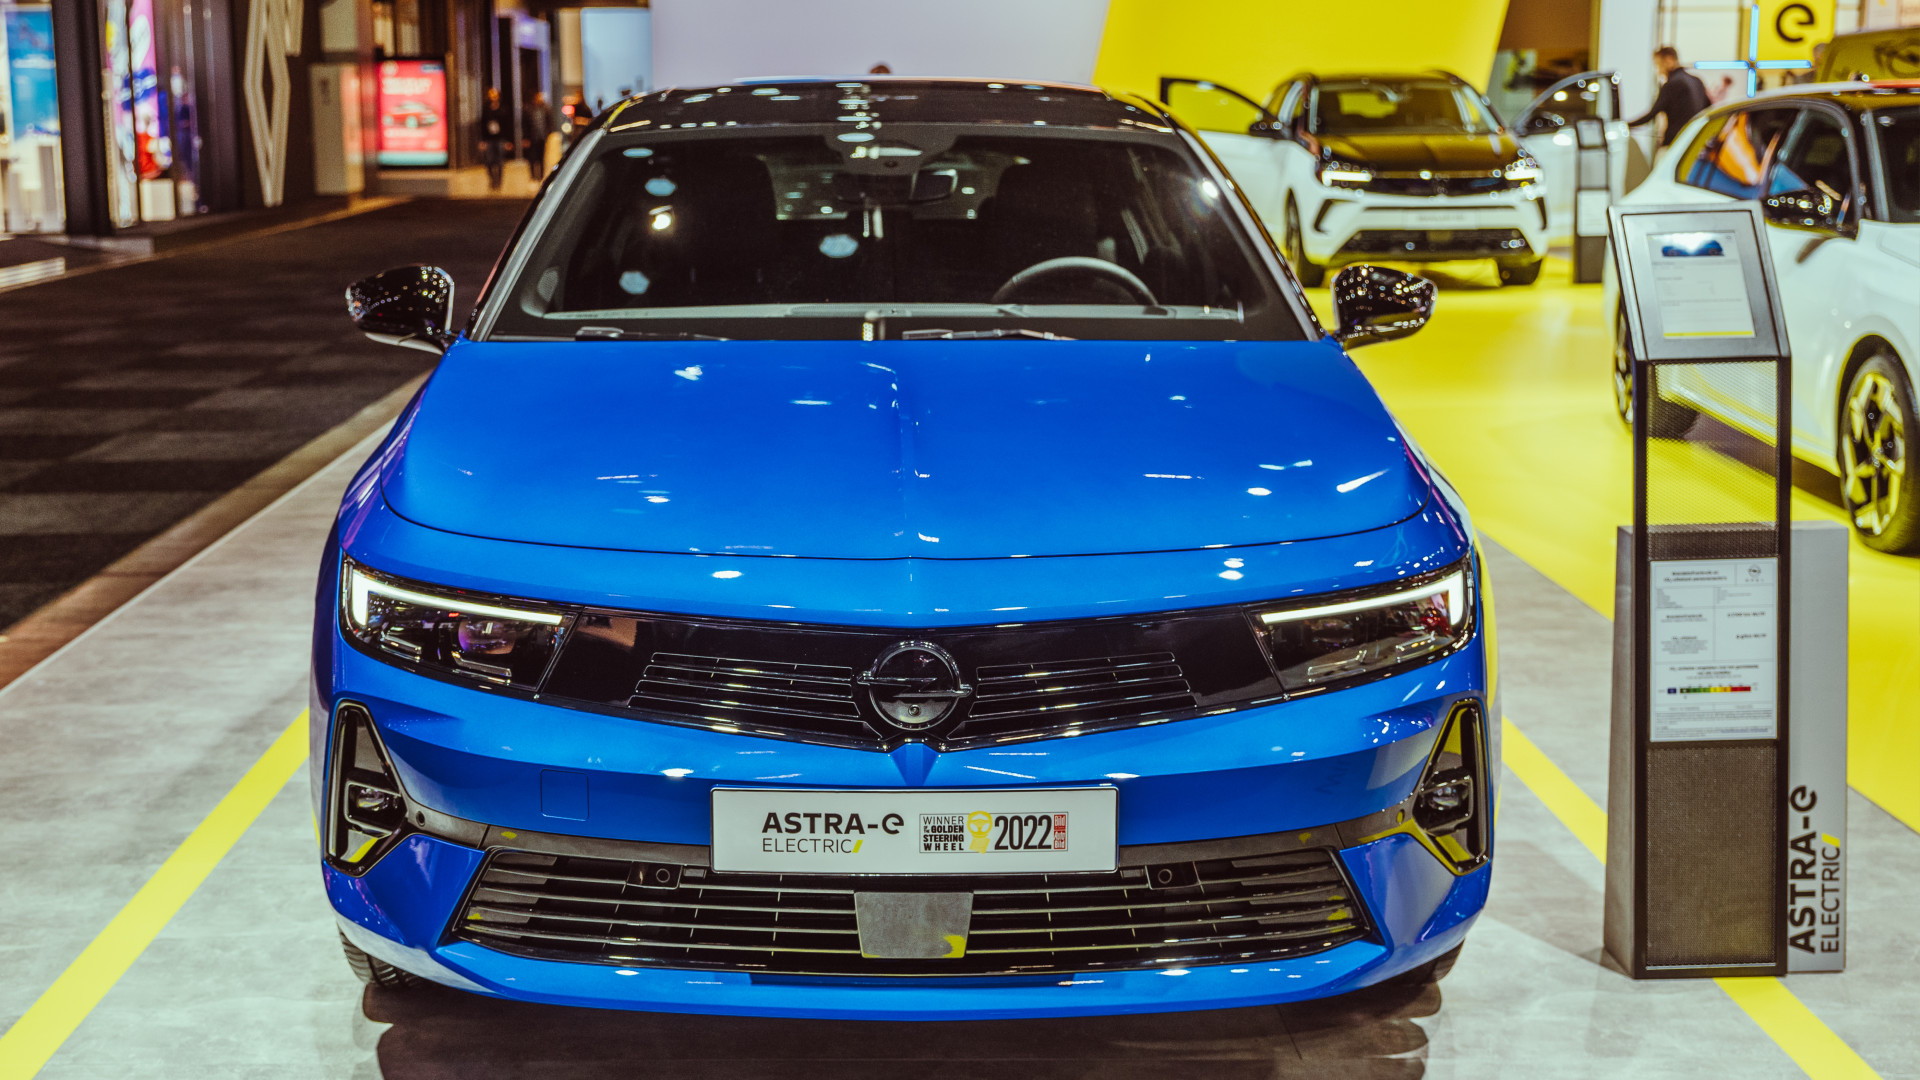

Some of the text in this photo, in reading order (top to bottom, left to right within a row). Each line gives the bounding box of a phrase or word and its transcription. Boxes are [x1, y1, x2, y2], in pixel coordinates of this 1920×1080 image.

[1776, 4, 1814, 43] e
[762, 812, 905, 835] ASTRA-e
[923, 816, 965, 825] WINNER
[931, 825, 965, 833] GOLDEN
[923, 834, 965, 843] STEERING
[994, 815, 1052, 850] 2022
[762, 838, 853, 853] ELECTRIC
[923, 843, 965, 851] WHEEL
[1788, 784, 1817, 954] ASTRA-e
[1821, 847, 1840, 952] ELECTRIC
